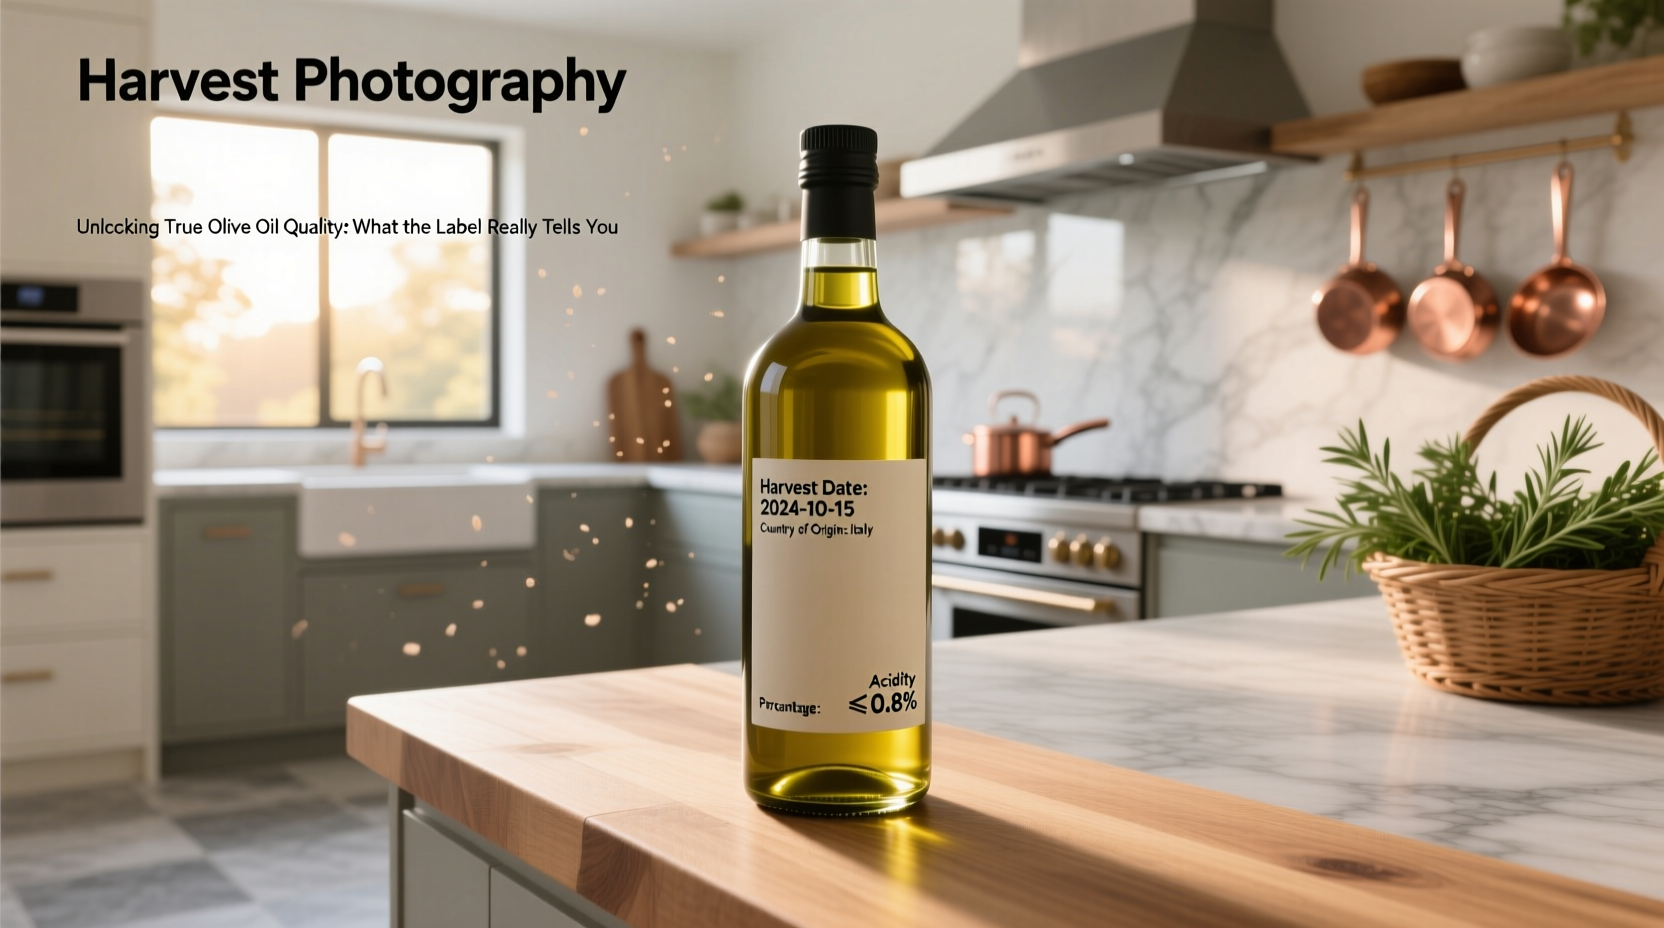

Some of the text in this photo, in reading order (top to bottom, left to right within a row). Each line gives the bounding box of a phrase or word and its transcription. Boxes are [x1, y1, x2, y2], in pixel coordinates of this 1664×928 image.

[760, 478, 868, 496] Harvest Date:
[760, 499, 855, 517] 2024-10-15
[869, 671, 916, 689] Acidity
